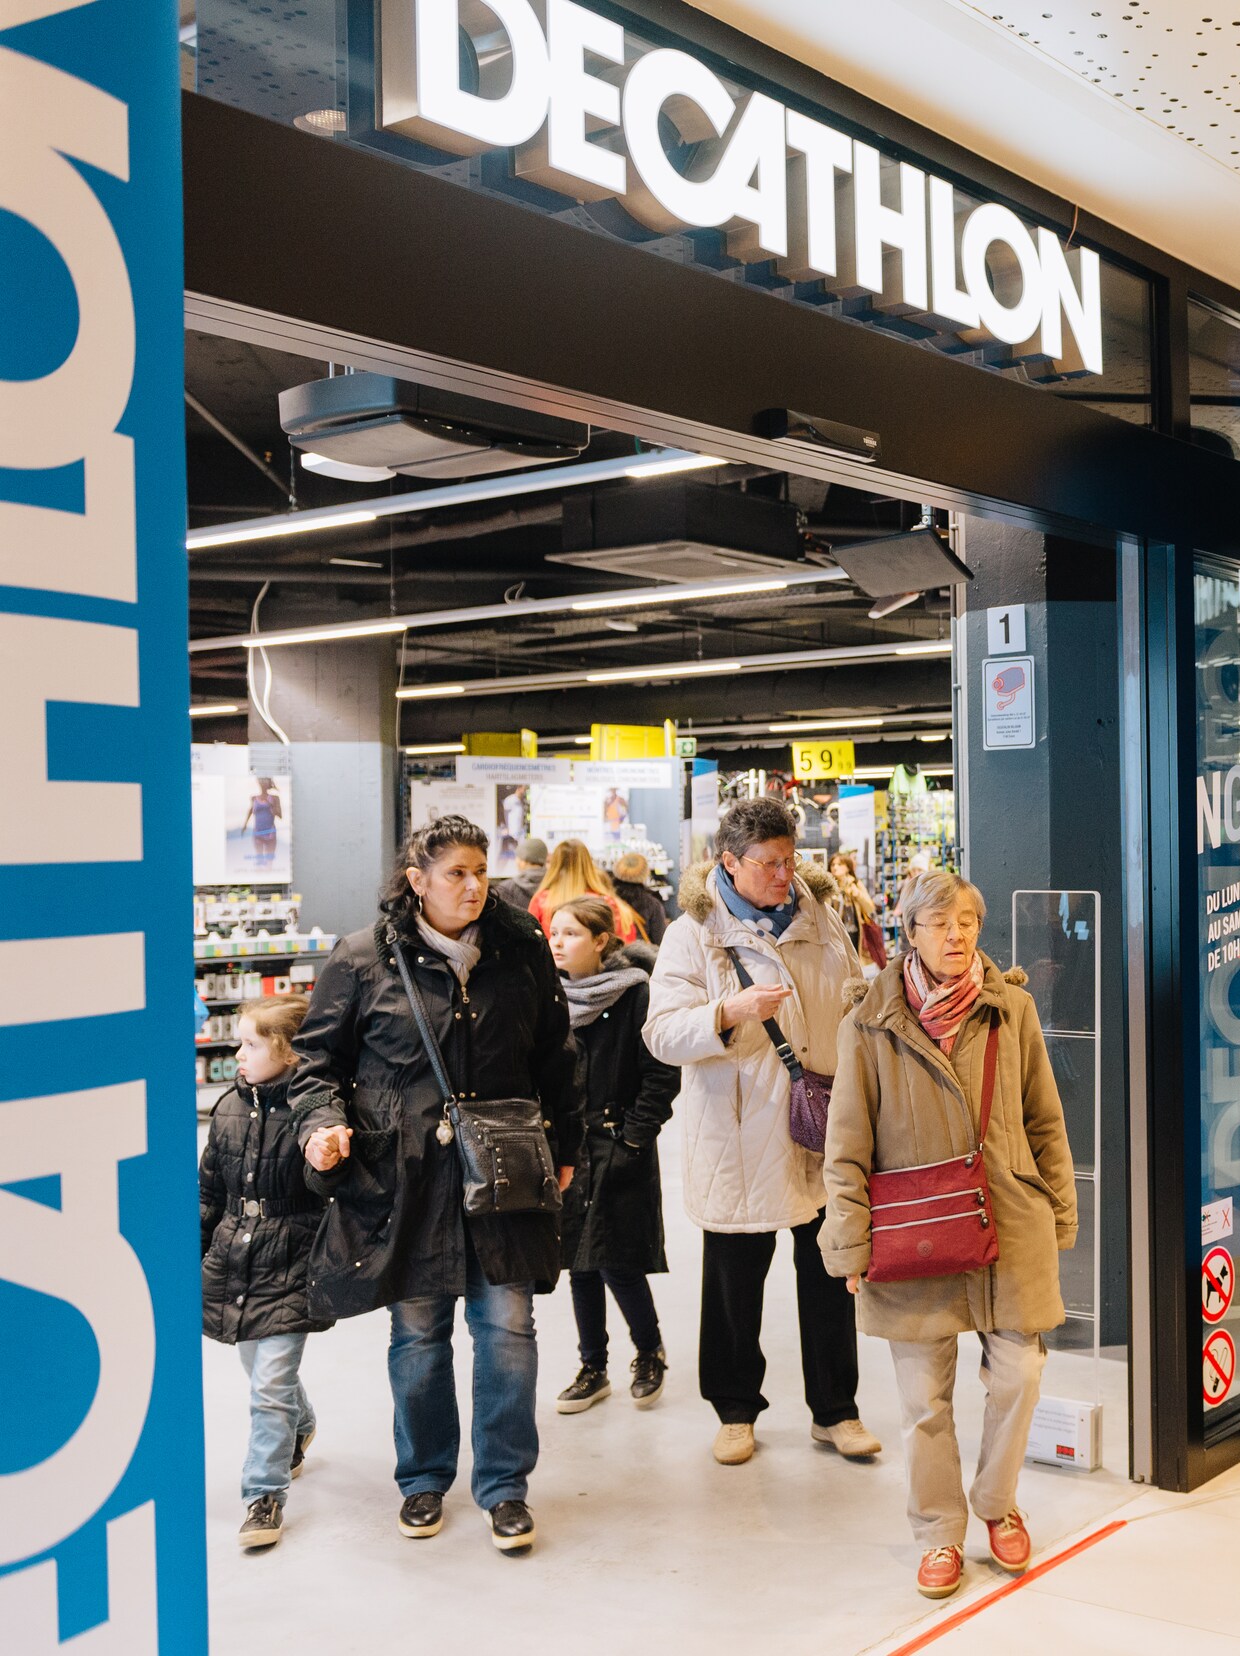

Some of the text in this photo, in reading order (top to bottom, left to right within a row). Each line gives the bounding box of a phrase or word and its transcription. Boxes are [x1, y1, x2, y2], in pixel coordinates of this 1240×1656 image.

[417, 0, 1104, 375] DECATHLON
[999, 613, 1010, 645] 1
[1206, 890, 1220, 915] DU
[1207, 919, 1221, 944] AU
[1208, 948, 1221, 972] DE
[1222, 938, 1240, 964] 10H
